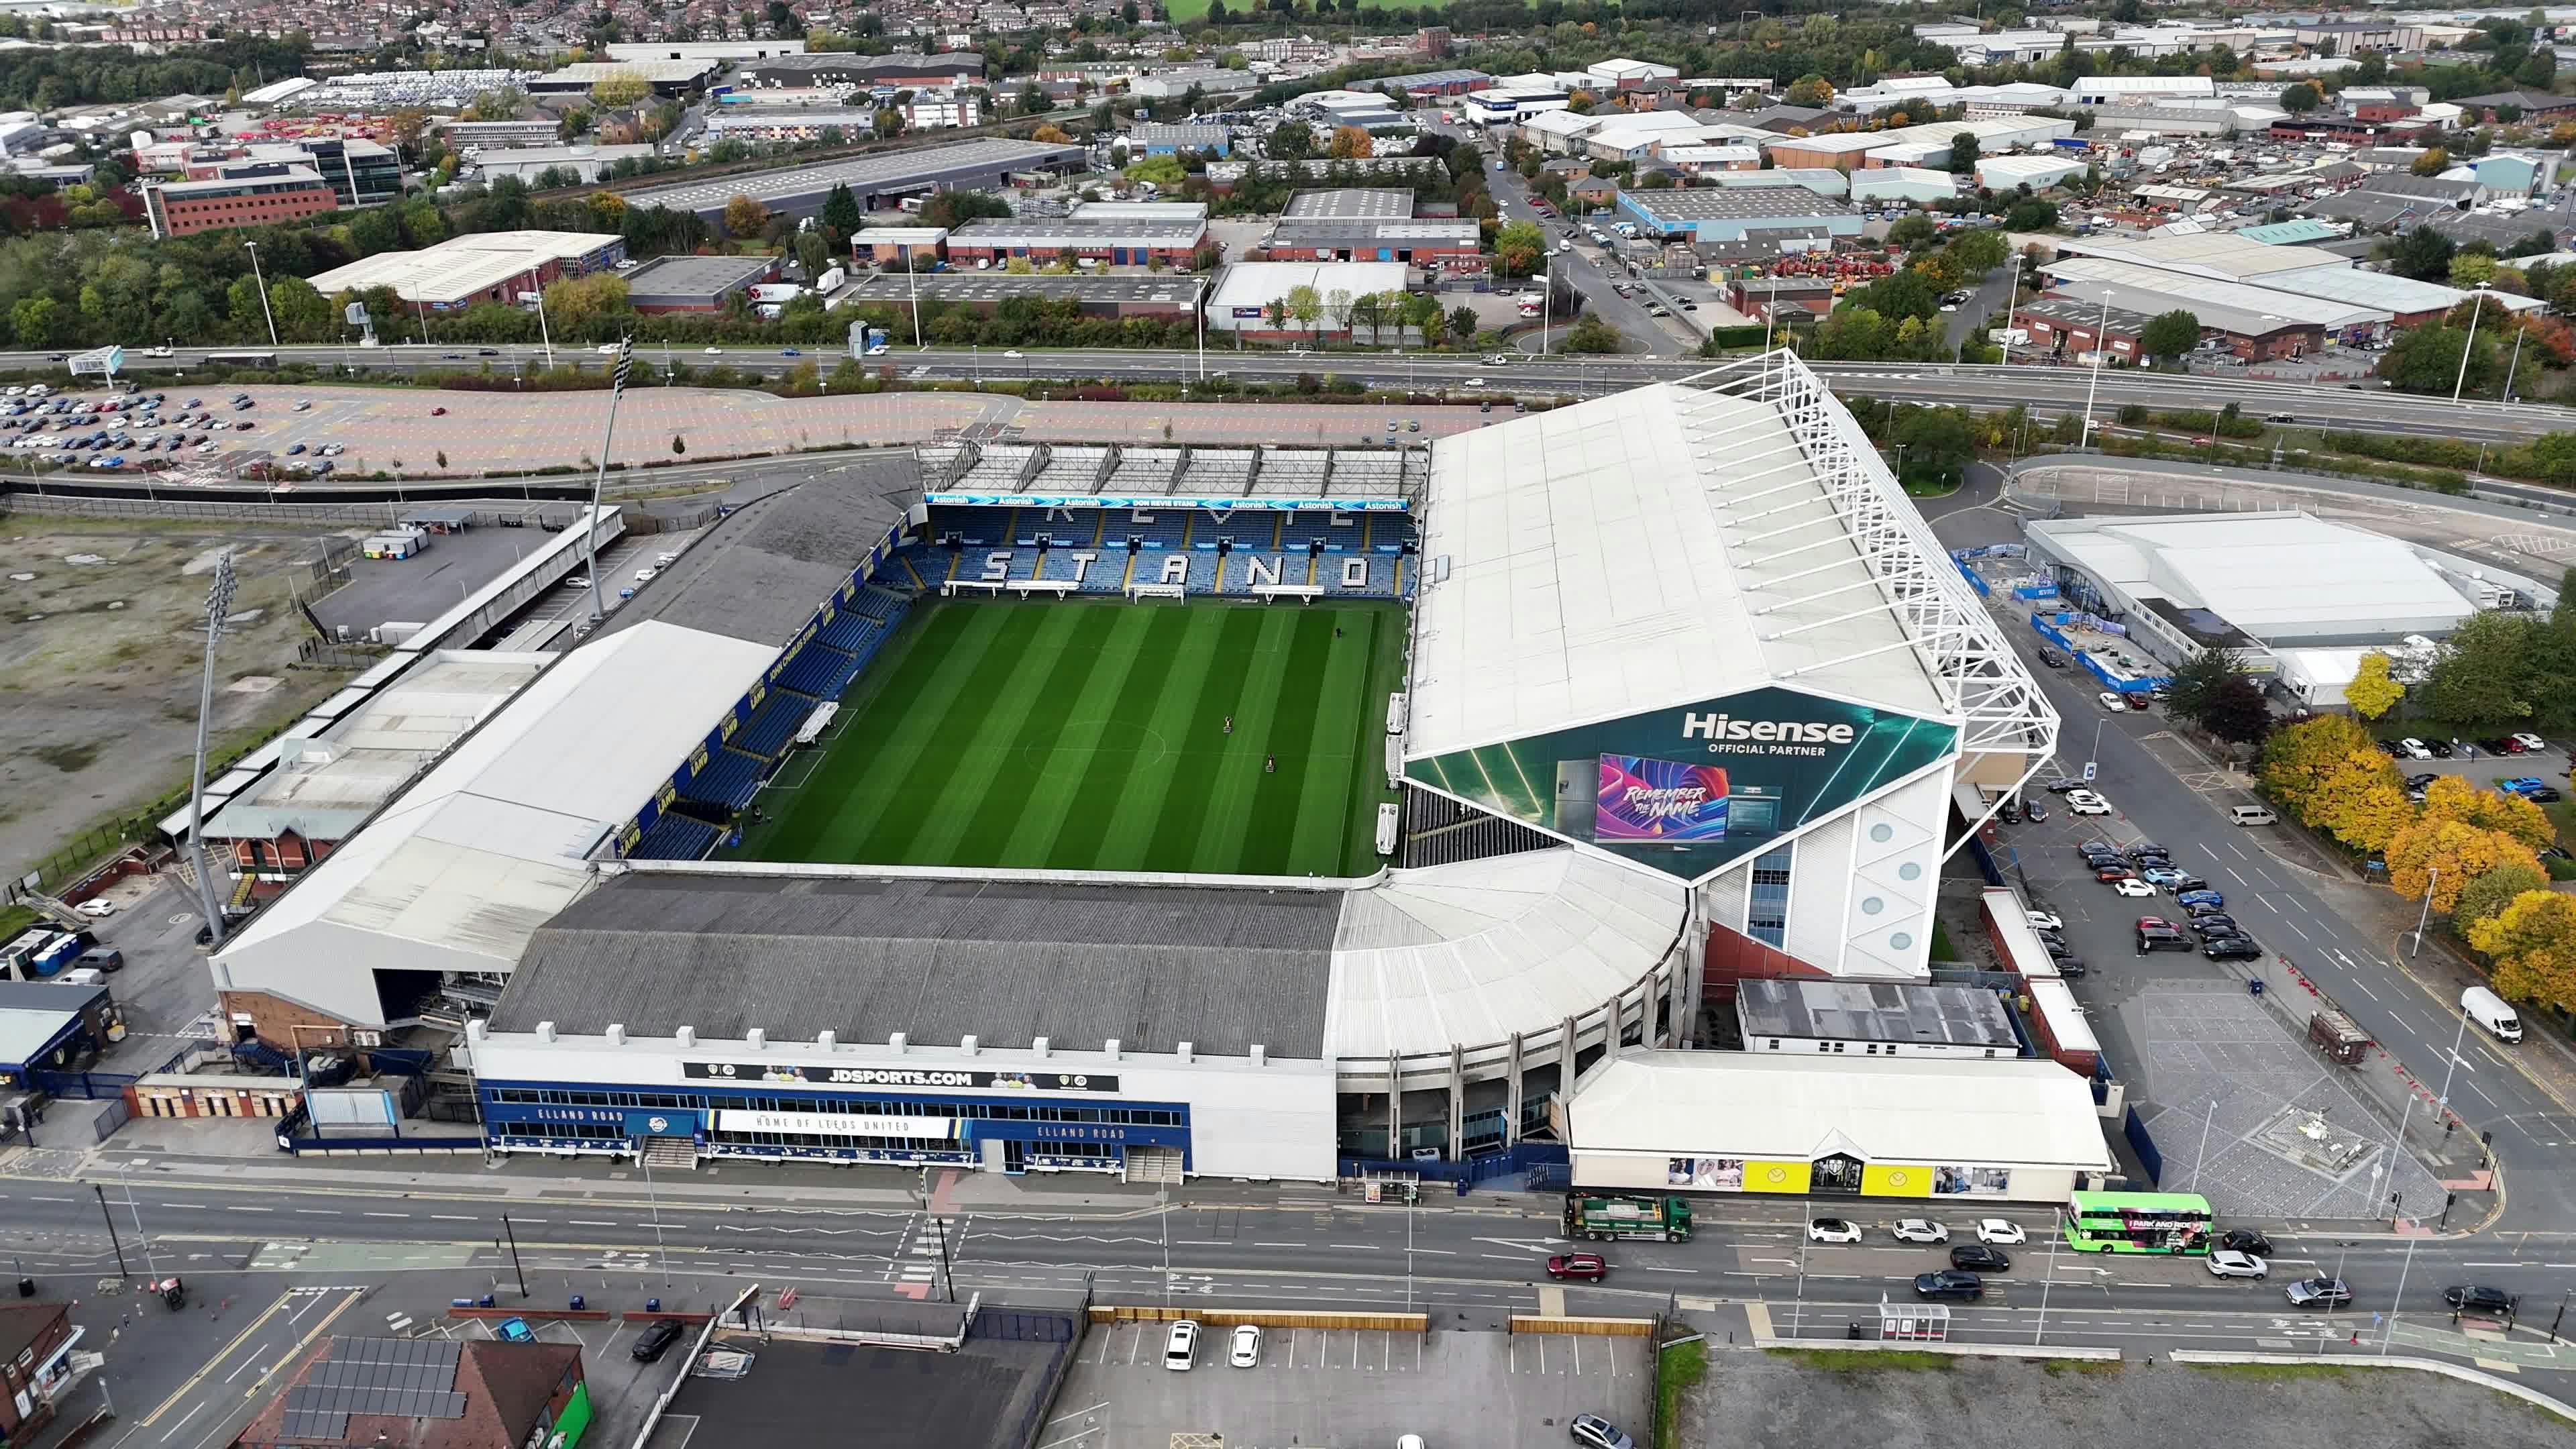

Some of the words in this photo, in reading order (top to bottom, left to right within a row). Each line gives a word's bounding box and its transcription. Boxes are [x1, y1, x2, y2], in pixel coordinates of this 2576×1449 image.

[762, 289, 773, 297] dpd
[932, 496, 968, 504] Astonish
[998, 496, 1034, 505] Astonish
[1064, 497, 1100, 506] Astonish
[1231, 500, 1267, 508] Astonish
[1297, 500, 1334, 509] Astonish
[1364, 501, 1401, 510] Astonish
[981, 552, 1367, 587] STAND
[803, 623, 817, 644] STAND
[1682, 712, 1854, 744] Hisense
[1708, 743, 1765, 755] OFFICIAL
[1769, 745, 1826, 757] PARTNER
[1623, 786, 1707, 803] REMEMBER
[657, 788, 676, 816] LAND
[828, 1069, 973, 1086] JDSPORTS.COM
[538, 1109, 584, 1120] ELLAND
[592, 1111, 623, 1122] ROAD
[757, 1117, 788, 1127] HOME
[797, 1118, 809, 1128] OF
[818, 1119, 856, 1130] LEEDS
[864, 1120, 909, 1131] UNITED
[1037, 1126, 1084, 1138] ELLAND
[1093, 1128, 1125, 1139] ROAD
[2133, 1220, 2154, 1228] PARK
